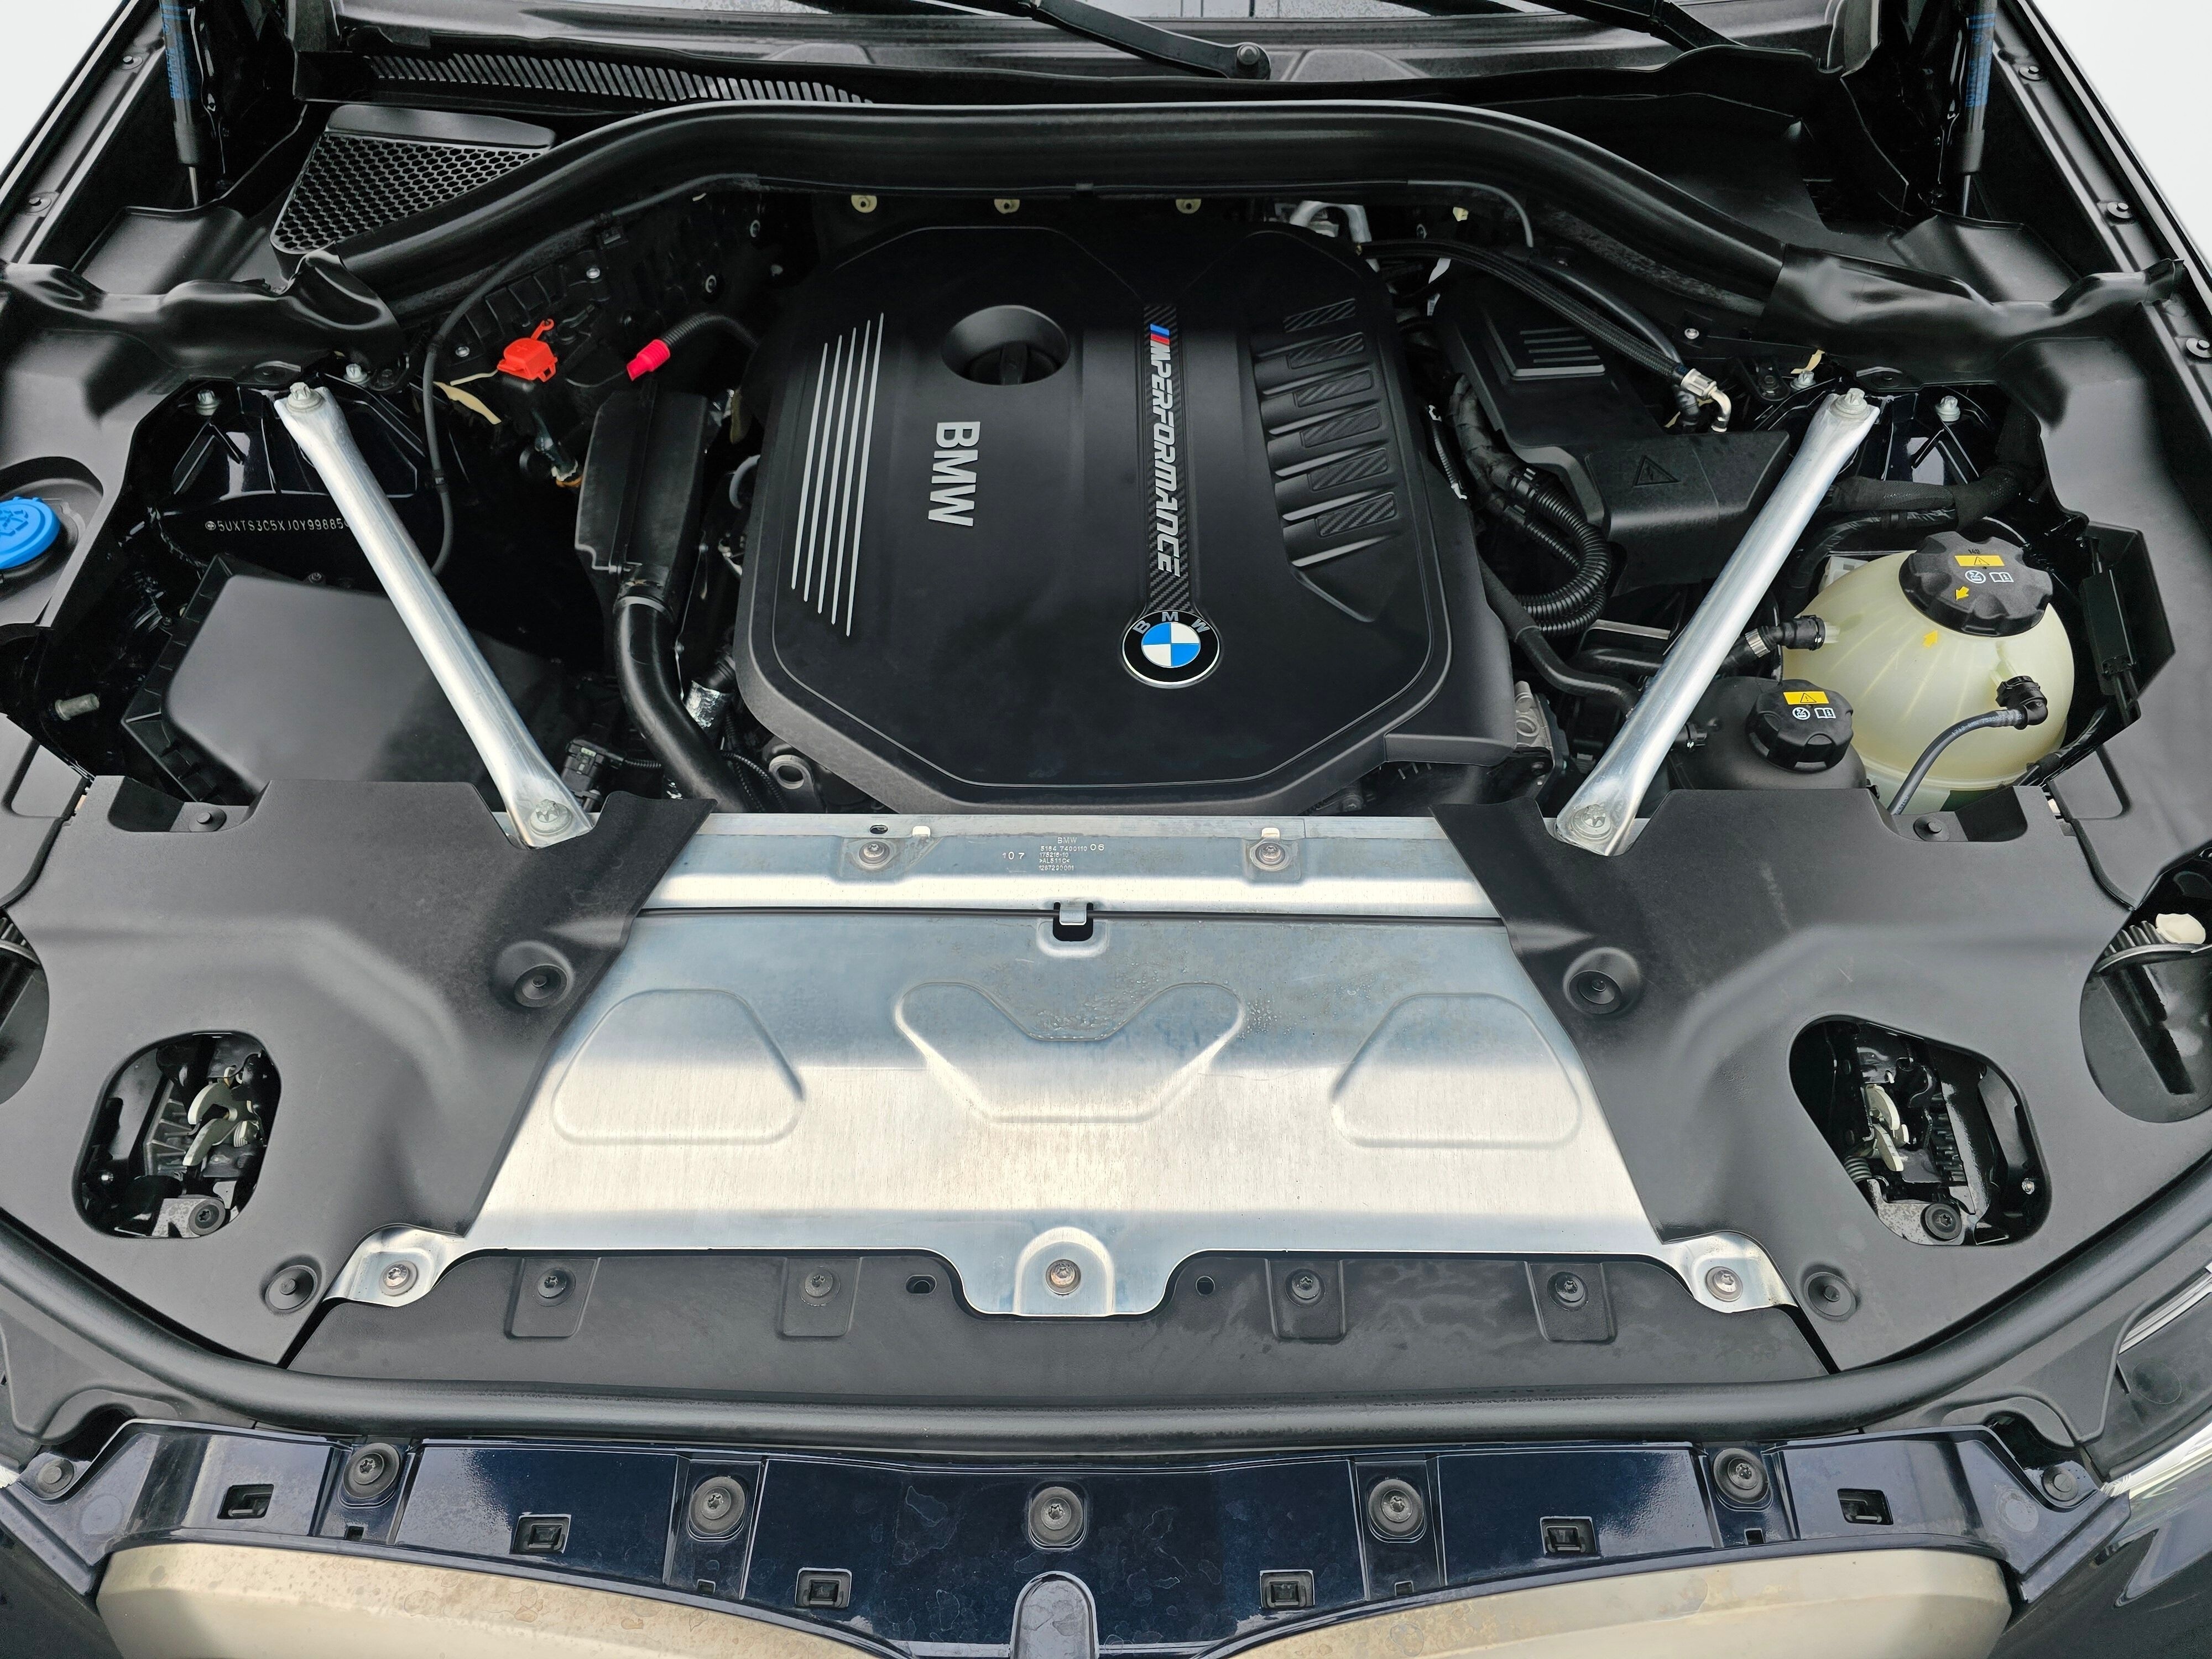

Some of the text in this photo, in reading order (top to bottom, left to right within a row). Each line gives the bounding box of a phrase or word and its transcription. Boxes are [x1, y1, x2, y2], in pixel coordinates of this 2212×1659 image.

[928, 421, 981, 526] BMW
[1151, 360, 1181, 577] PERFORMANCE
[1132, 611, 1211, 634] BMW
